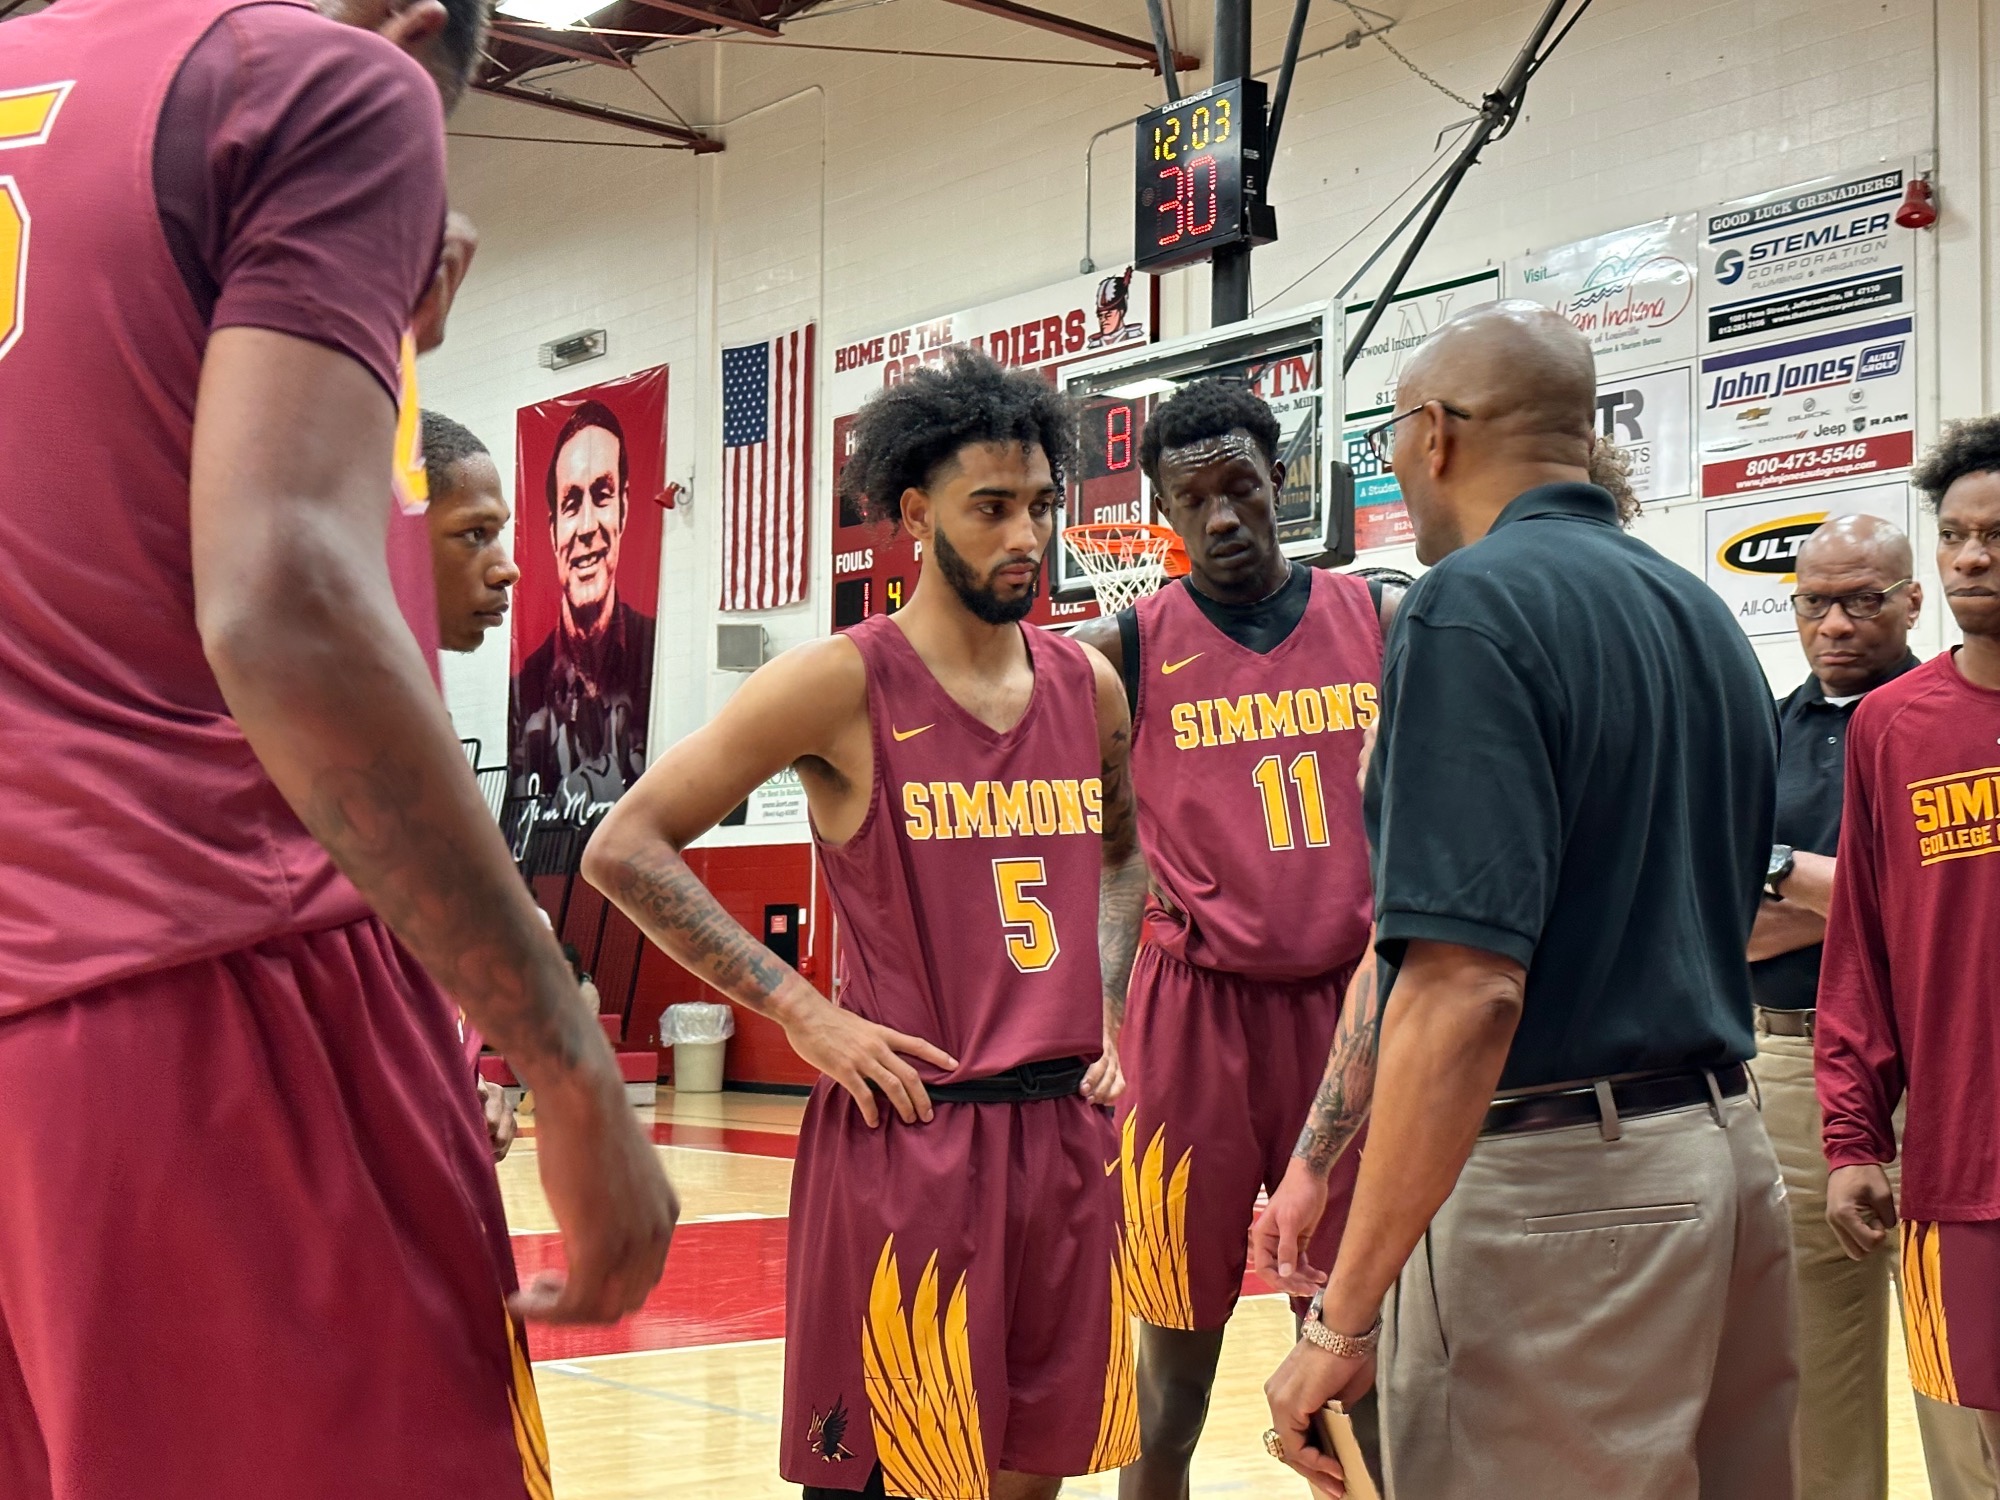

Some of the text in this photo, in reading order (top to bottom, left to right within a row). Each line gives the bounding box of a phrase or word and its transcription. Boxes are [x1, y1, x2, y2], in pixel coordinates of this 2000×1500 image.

[1162, 88, 1213, 114] DAKTRONICS
[1159, 155, 1216, 245] 30
[1712, 175, 1899, 232] GOOD LUCK GRENADIERS!
[1749, 213, 1890, 261] STEMLER
[1747, 240, 1888, 280] CORPORATION
[1752, 272, 1803, 289] PLUMBING
[1820, 256, 1878, 274] IRRIGATION
[1602, 285, 1665, 328] Indiana
[835, 316, 953, 373] HOME OF THE
[1867, 351, 1896, 363] AUTO
[1706, 355, 1855, 409] John Jones
[1861, 360, 1897, 373] GROUP
[1788, 410, 1830, 422] BUICK
[1814, 422, 1846, 438] Jeep
[1870, 413, 1908, 426] RAM
[1107, 405, 1131, 471] 8
[1736, 460, 1877, 490] www.johnjonesautogroup.com
[1746, 443, 1867, 477] 800-473-5546
[1094, 501, 1140, 524] FOULS
[836, 549, 873, 574] FOULS
[888, 581, 901, 609] 4
[1739, 598, 1787, 617] All-Out
[1171, 683, 1379, 750] SIMMONS
[902, 777, 1102, 841] SIMMONS
[1252, 751, 1330, 852] 11
[1919, 824, 1992, 857] COLLEGE
[991, 856, 1060, 973] 5
